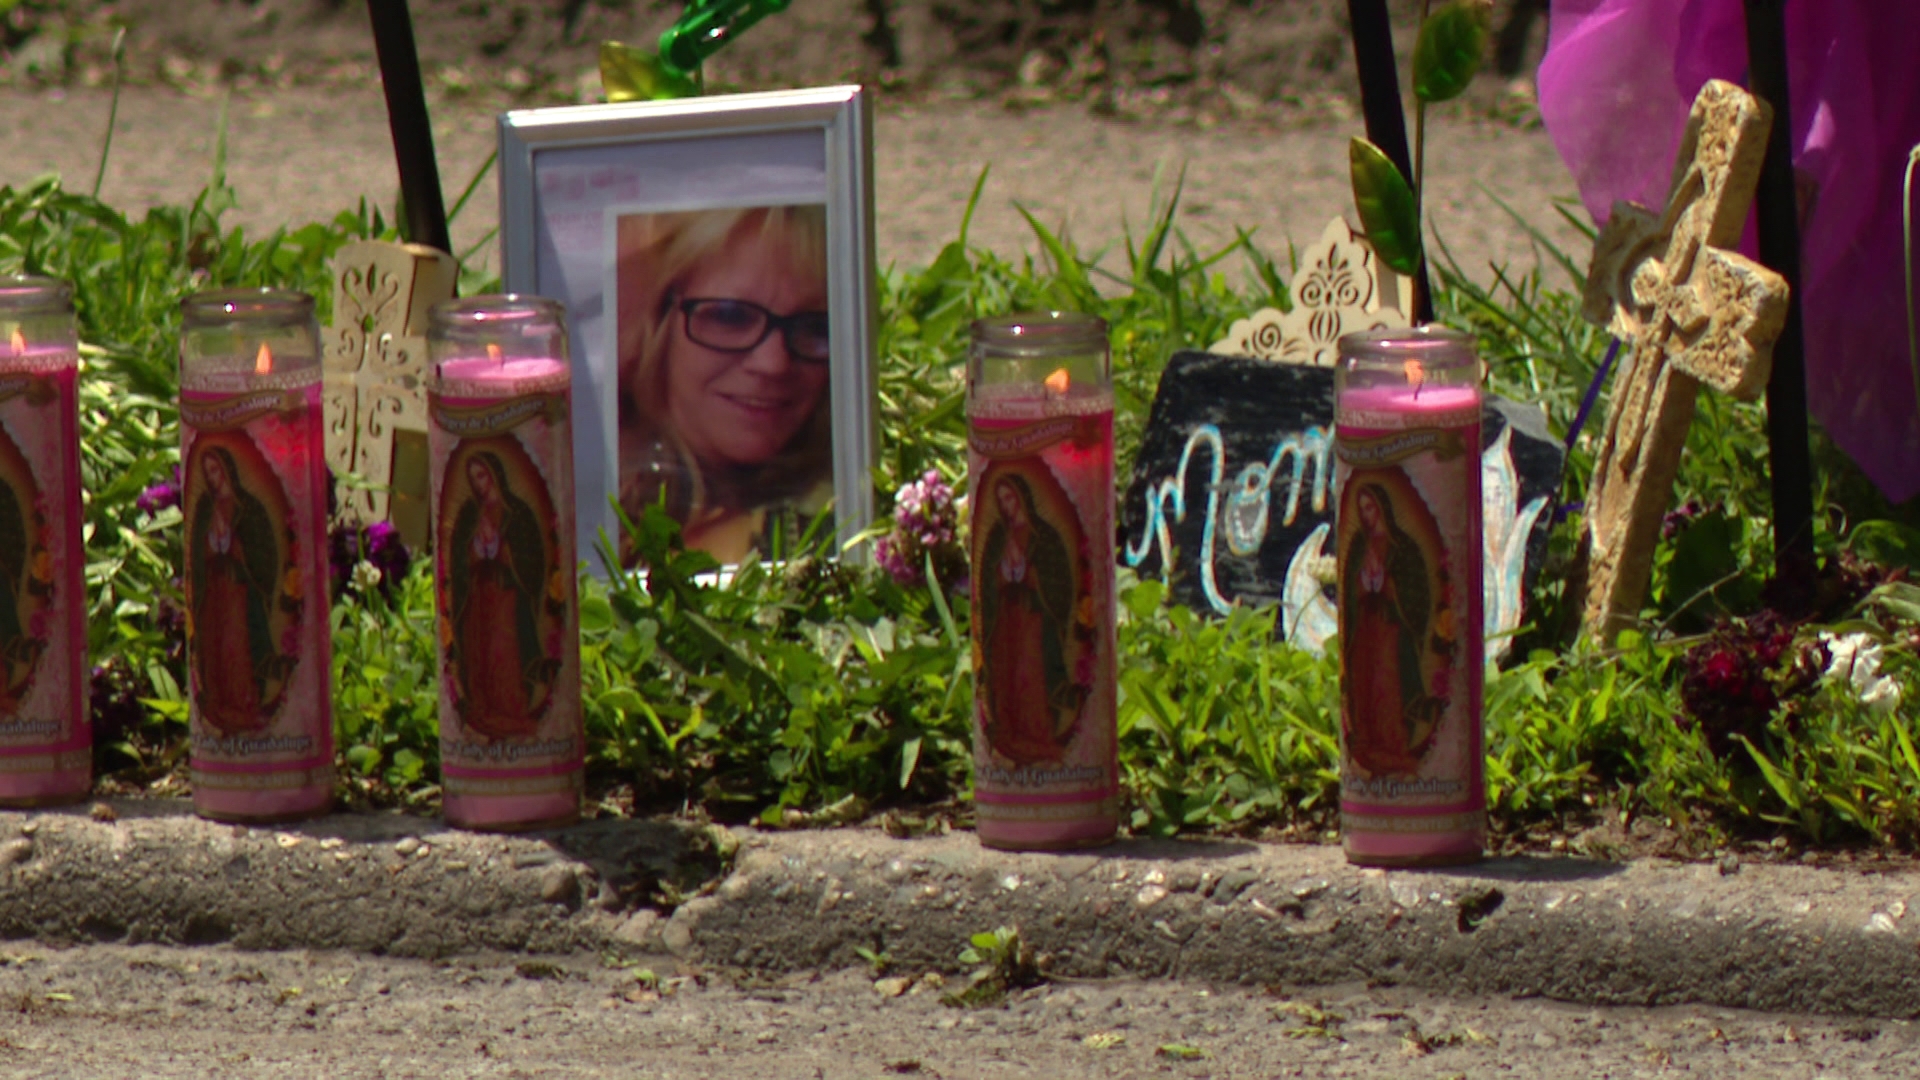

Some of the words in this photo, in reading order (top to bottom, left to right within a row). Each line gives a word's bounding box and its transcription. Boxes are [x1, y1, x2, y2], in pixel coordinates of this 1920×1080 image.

[238, 736, 312, 754] Guadalupe
[506, 739, 573, 761] Guadalupe
[1031, 765, 1104, 787] Guadalupe
[1386, 777, 1462, 797] Guadalupe
